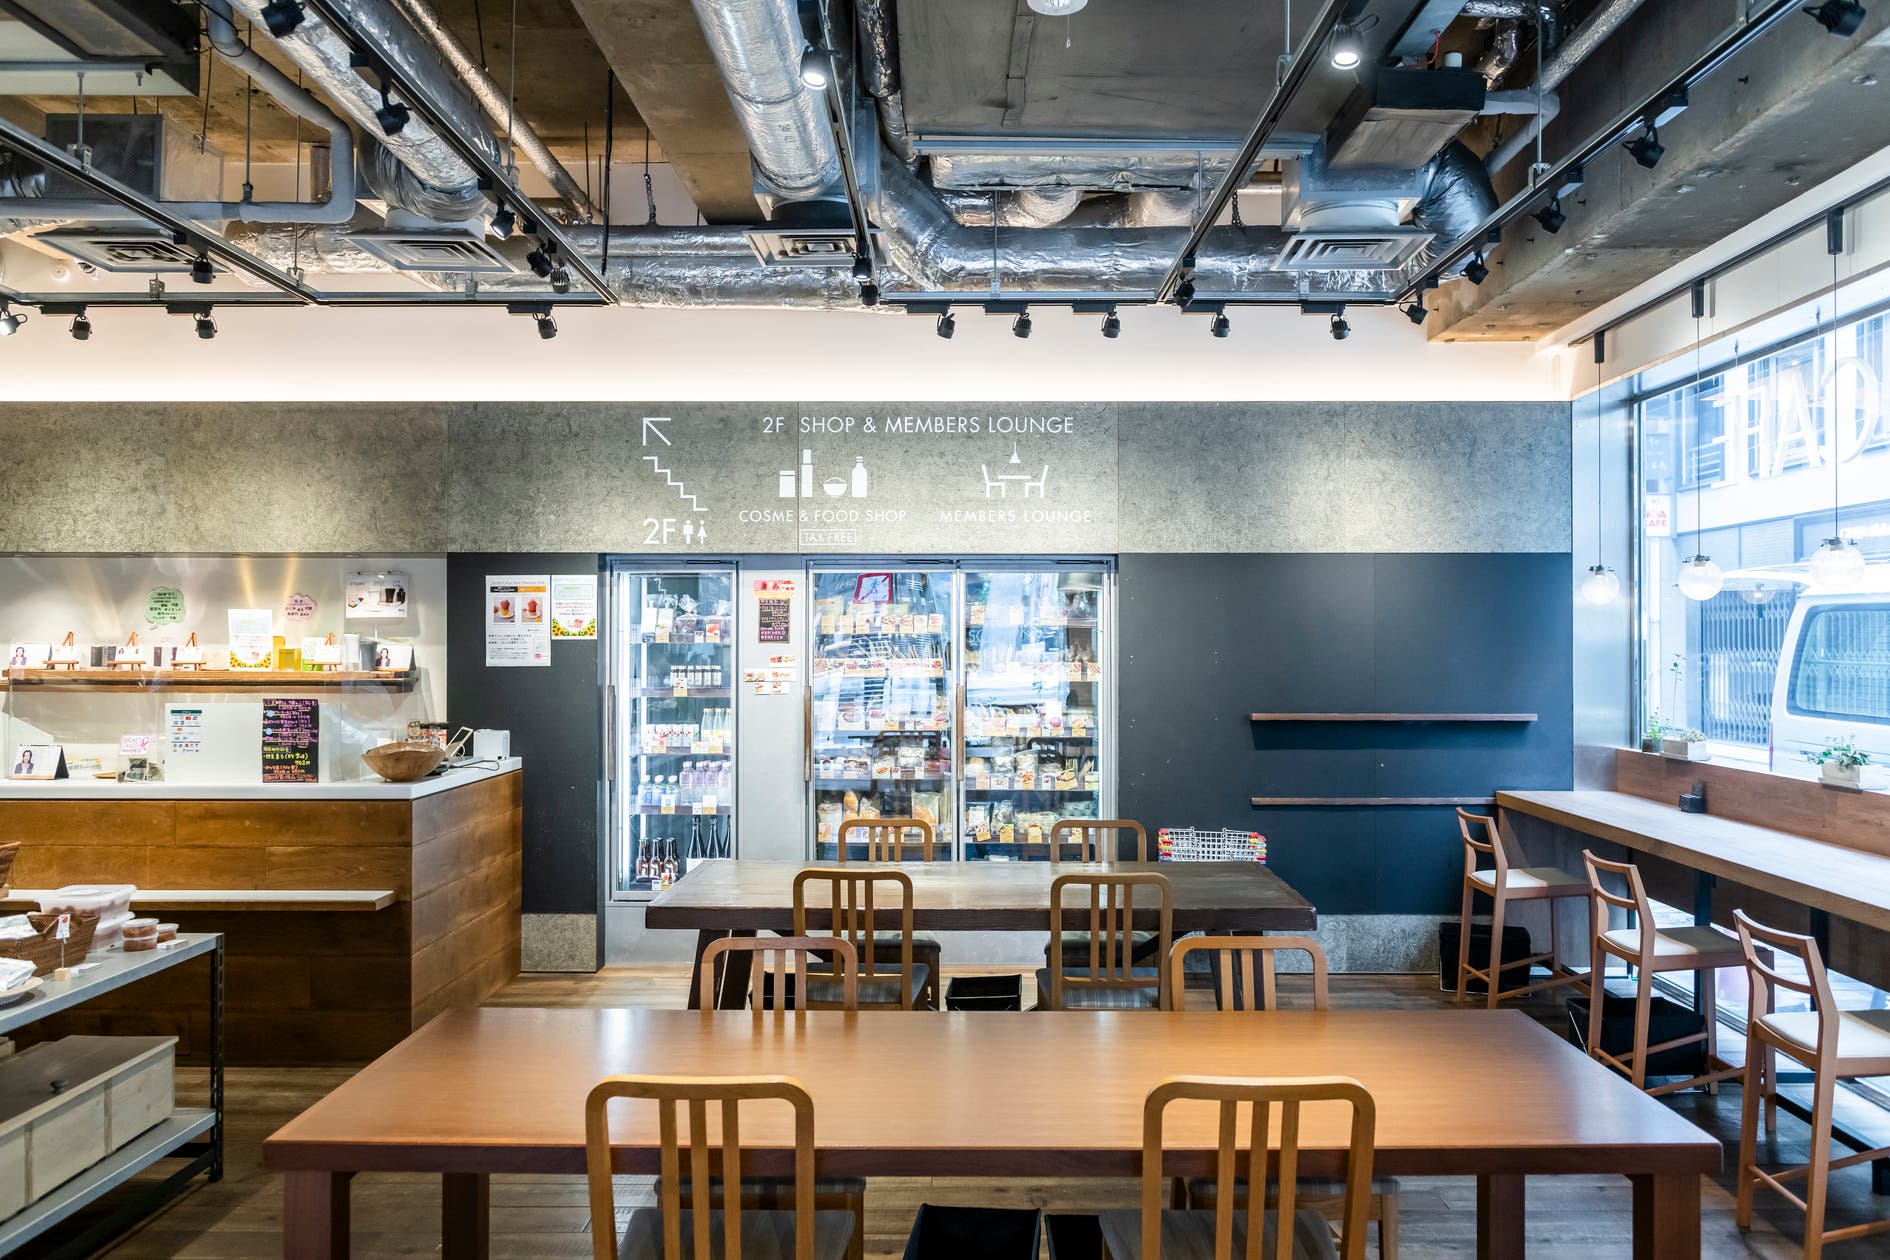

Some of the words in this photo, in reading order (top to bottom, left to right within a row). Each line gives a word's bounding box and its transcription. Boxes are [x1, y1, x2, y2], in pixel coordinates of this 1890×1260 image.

[762, 416, 785, 433] 2F
[800, 416, 855, 433] SHOP
[863, 416, 877, 433] &
[885, 416, 980, 433] MEMBERS
[988, 416, 1074, 433] LOUNGE
[738, 509, 794, 523] COSME
[799, 509, 809, 522] &
[814, 509, 859, 522] FOOD
[864, 509, 907, 522] SHOP
[939, 510, 1016, 522] MEMBERS
[1024, 510, 1092, 523] LOUNGE
[642, 517, 677, 545] 2F
[804, 532, 824, 543] TAX
[828, 532, 853, 543] FREE
